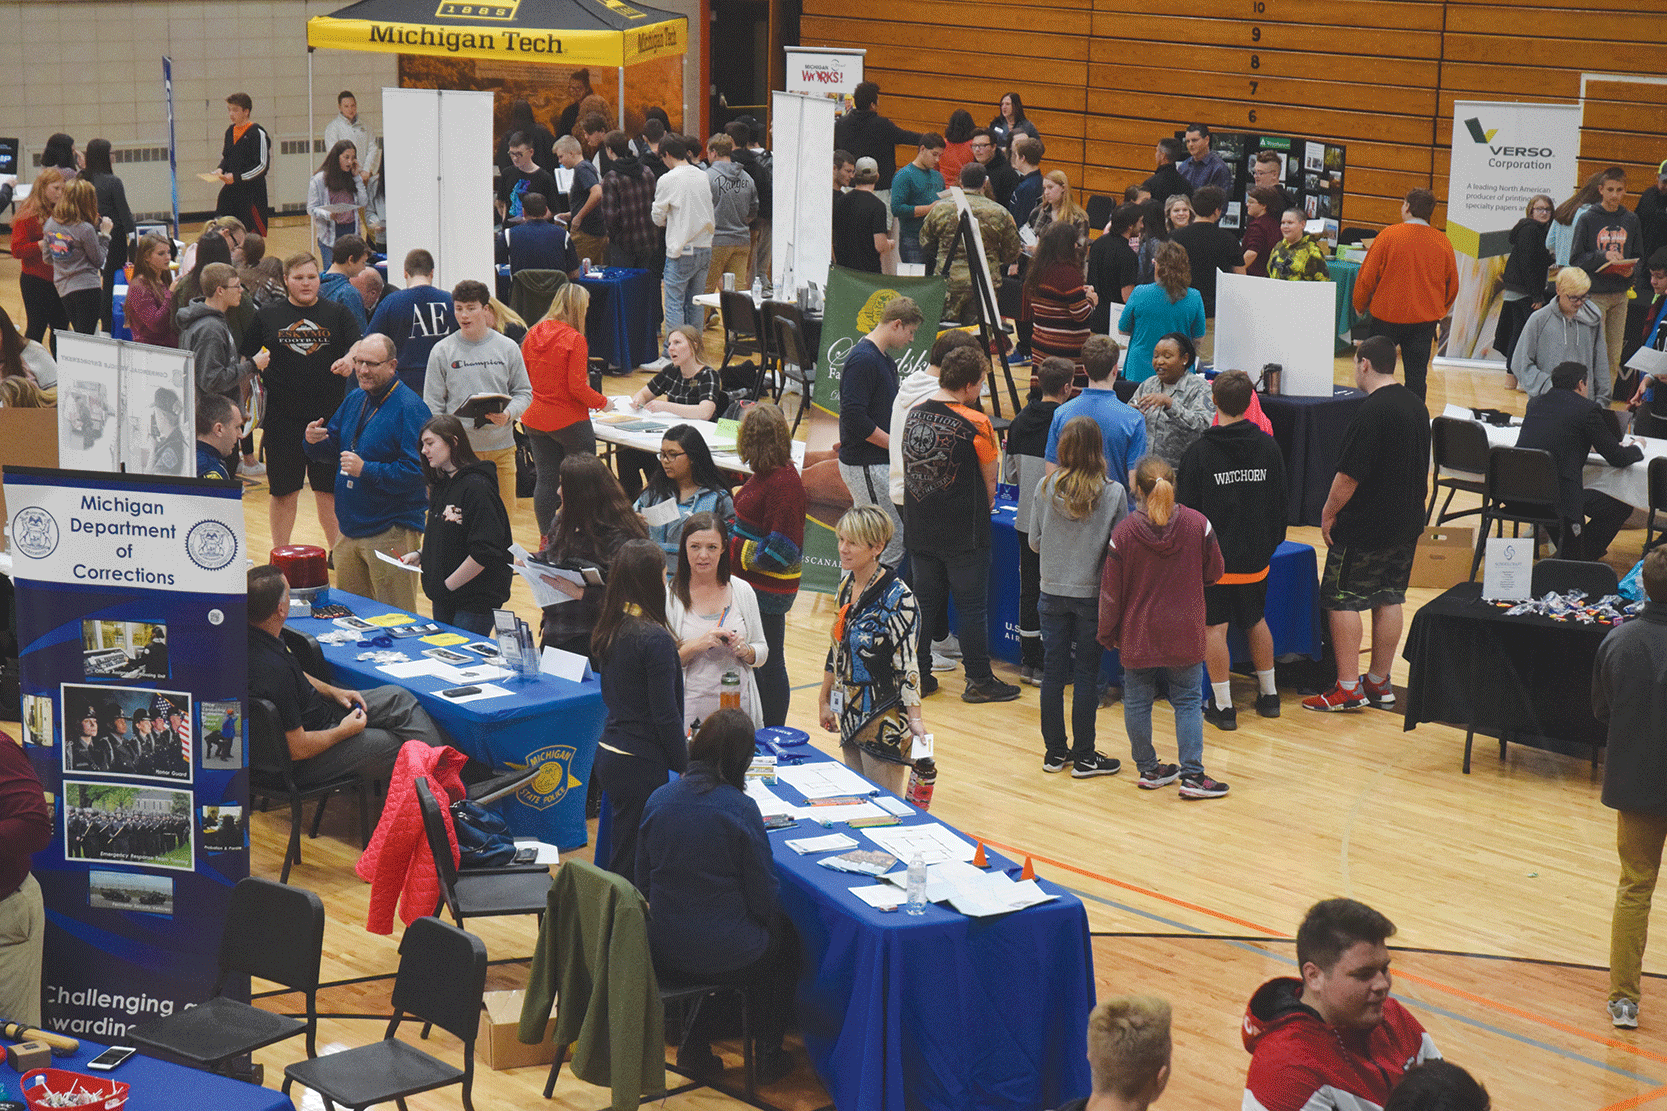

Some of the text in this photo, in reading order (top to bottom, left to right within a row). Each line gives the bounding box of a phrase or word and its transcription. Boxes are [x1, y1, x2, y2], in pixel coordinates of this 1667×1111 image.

[446, 4, 506, 16] 1885
[1253, 1, 1265, 13] 10
[368, 24, 564, 54] Michigan Tech
[1251, 27, 1261, 42] 9
[1250, 54, 1260, 69] 8
[1249, 81, 1258, 95] 7
[1248, 109, 1257, 123] 6
[1489, 145, 1553, 158] VERSO
[1488, 158, 1552, 170] Corporation
[1473, 183, 1498, 193] leading
[1466, 193, 1496, 201] producer
[1465, 202, 1494, 211] specialty
[408, 302, 450, 339] AE
[451, 359, 505, 369] Champion
[1213, 468, 1267, 486] WATCHORN
[80, 495, 164, 517] Michigan
[70, 517, 176, 539] Department
[116, 543, 133, 558] of
[72, 564, 175, 585] Corrections
[1004, 632, 1020, 643] AIR
[530, 749, 572, 767] MICHIGAN
[520, 786, 565, 804] STATE POLICE
[100, 851, 129, 859] Emergency
